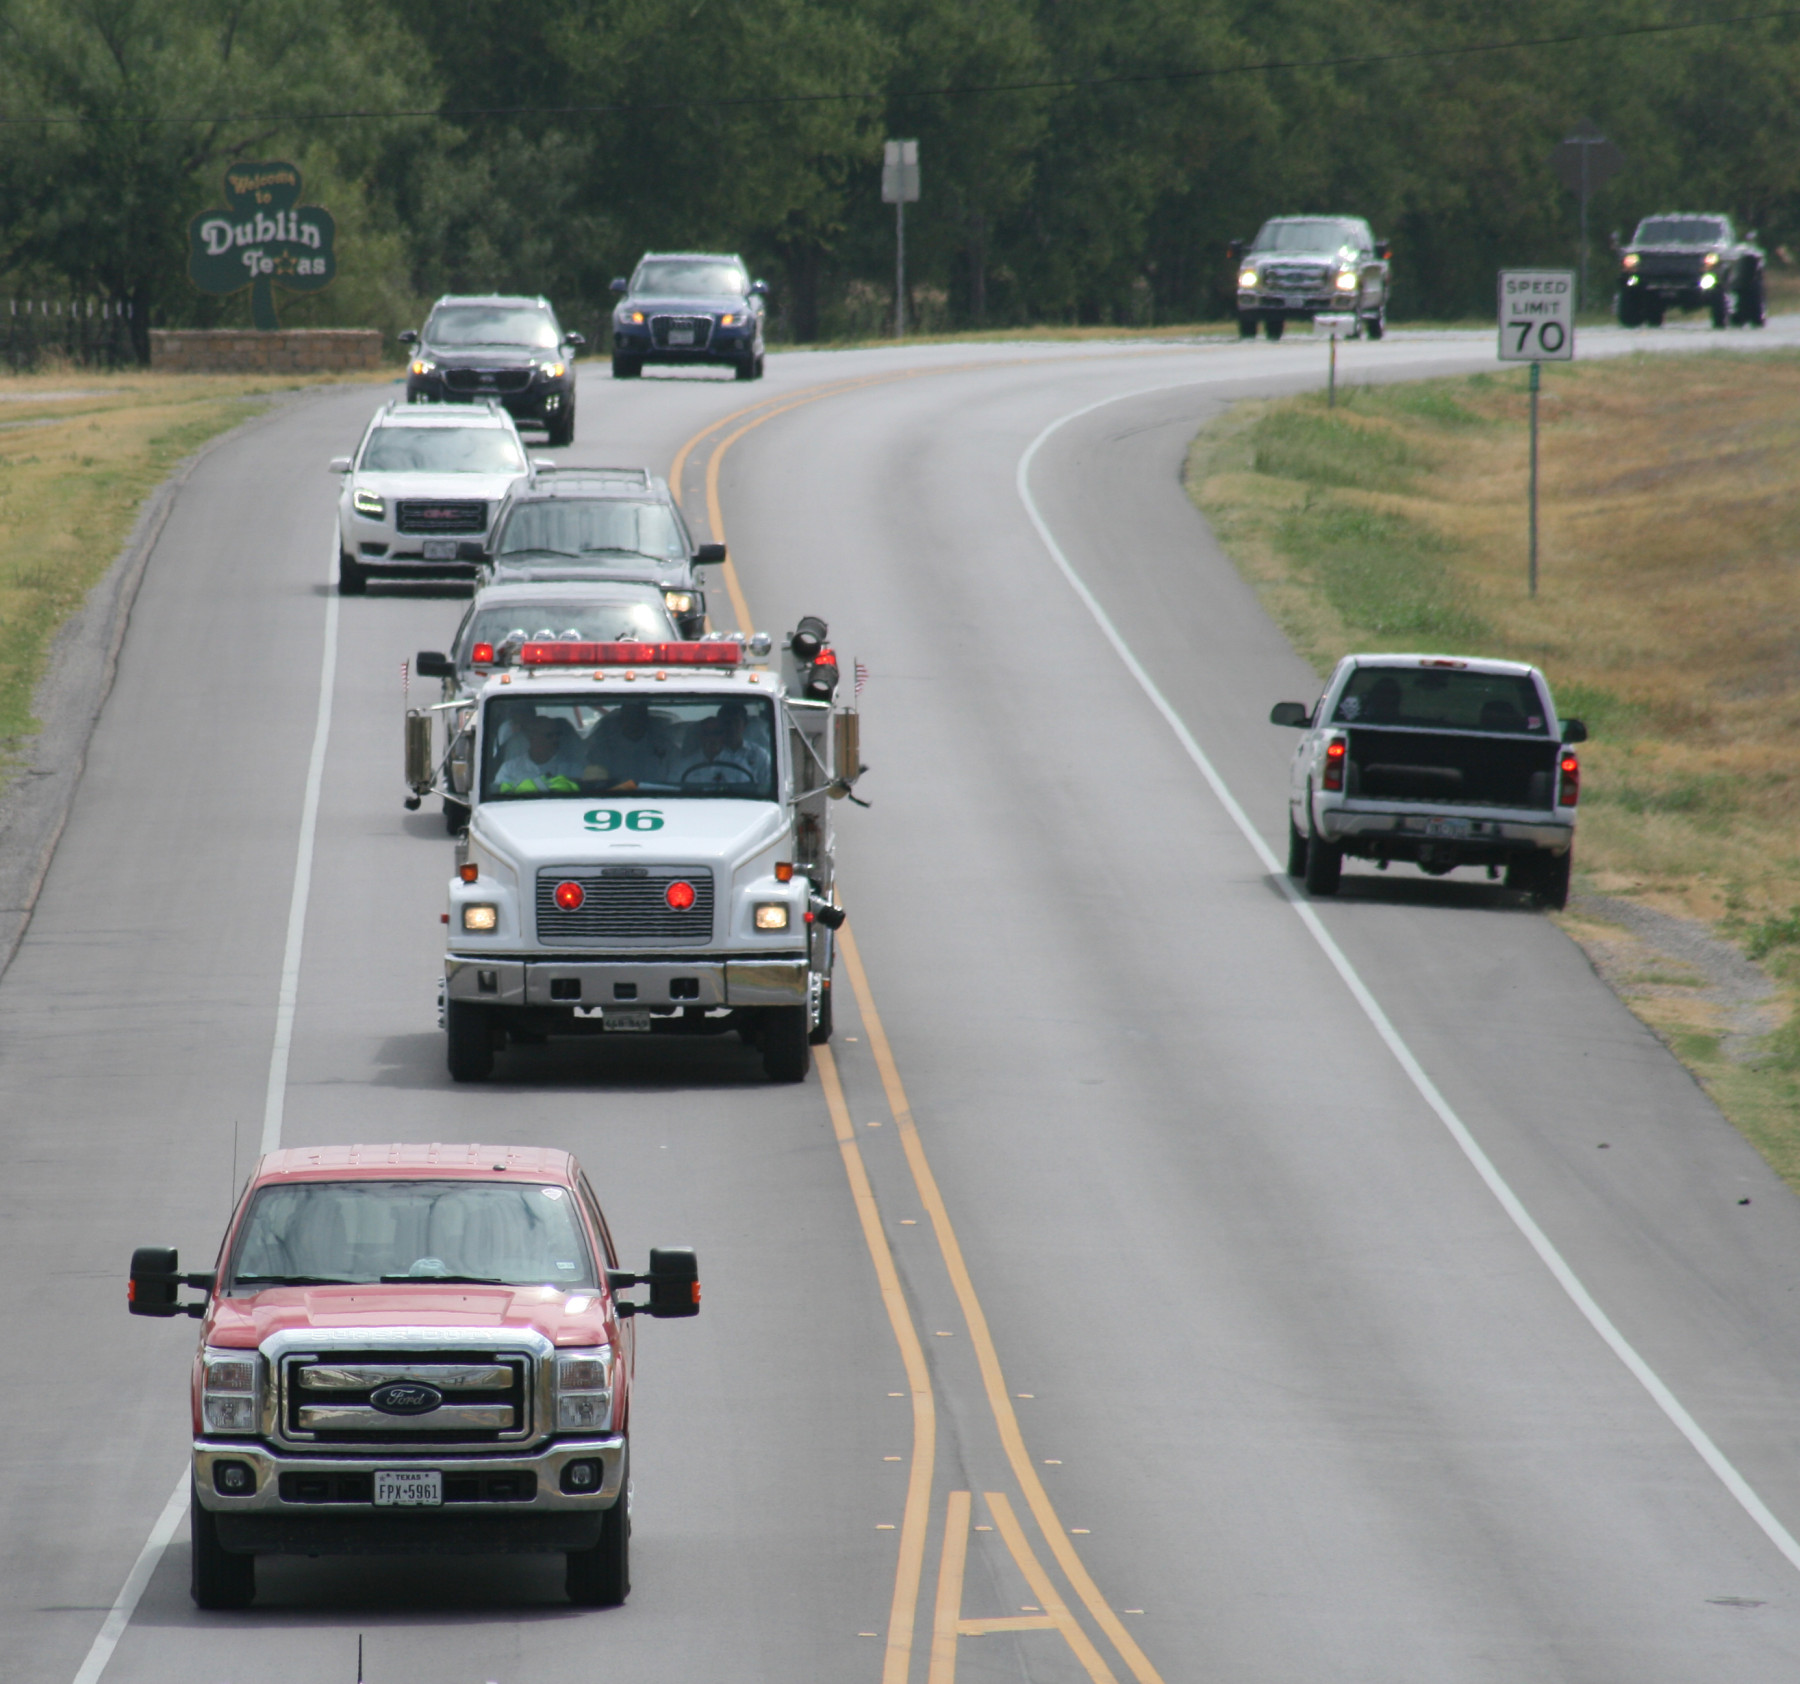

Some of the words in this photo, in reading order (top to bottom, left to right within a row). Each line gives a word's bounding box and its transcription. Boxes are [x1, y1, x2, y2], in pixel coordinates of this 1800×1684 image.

[229, 171, 296, 194] Welcome
[256, 191, 272, 204] to
[201, 210, 321, 255] Dublin
[242, 249, 326, 277] Teas
[1506, 280, 1567, 295] SPEED
[1512, 302, 1559, 315] LIMIT
[1507, 321, 1566, 353] 70
[583, 808, 665, 832] 96
[311, 1329, 408, 1341] SUPER
[422, 1329, 496, 1341] DUTY
[386, 1388, 425, 1406] Ford
